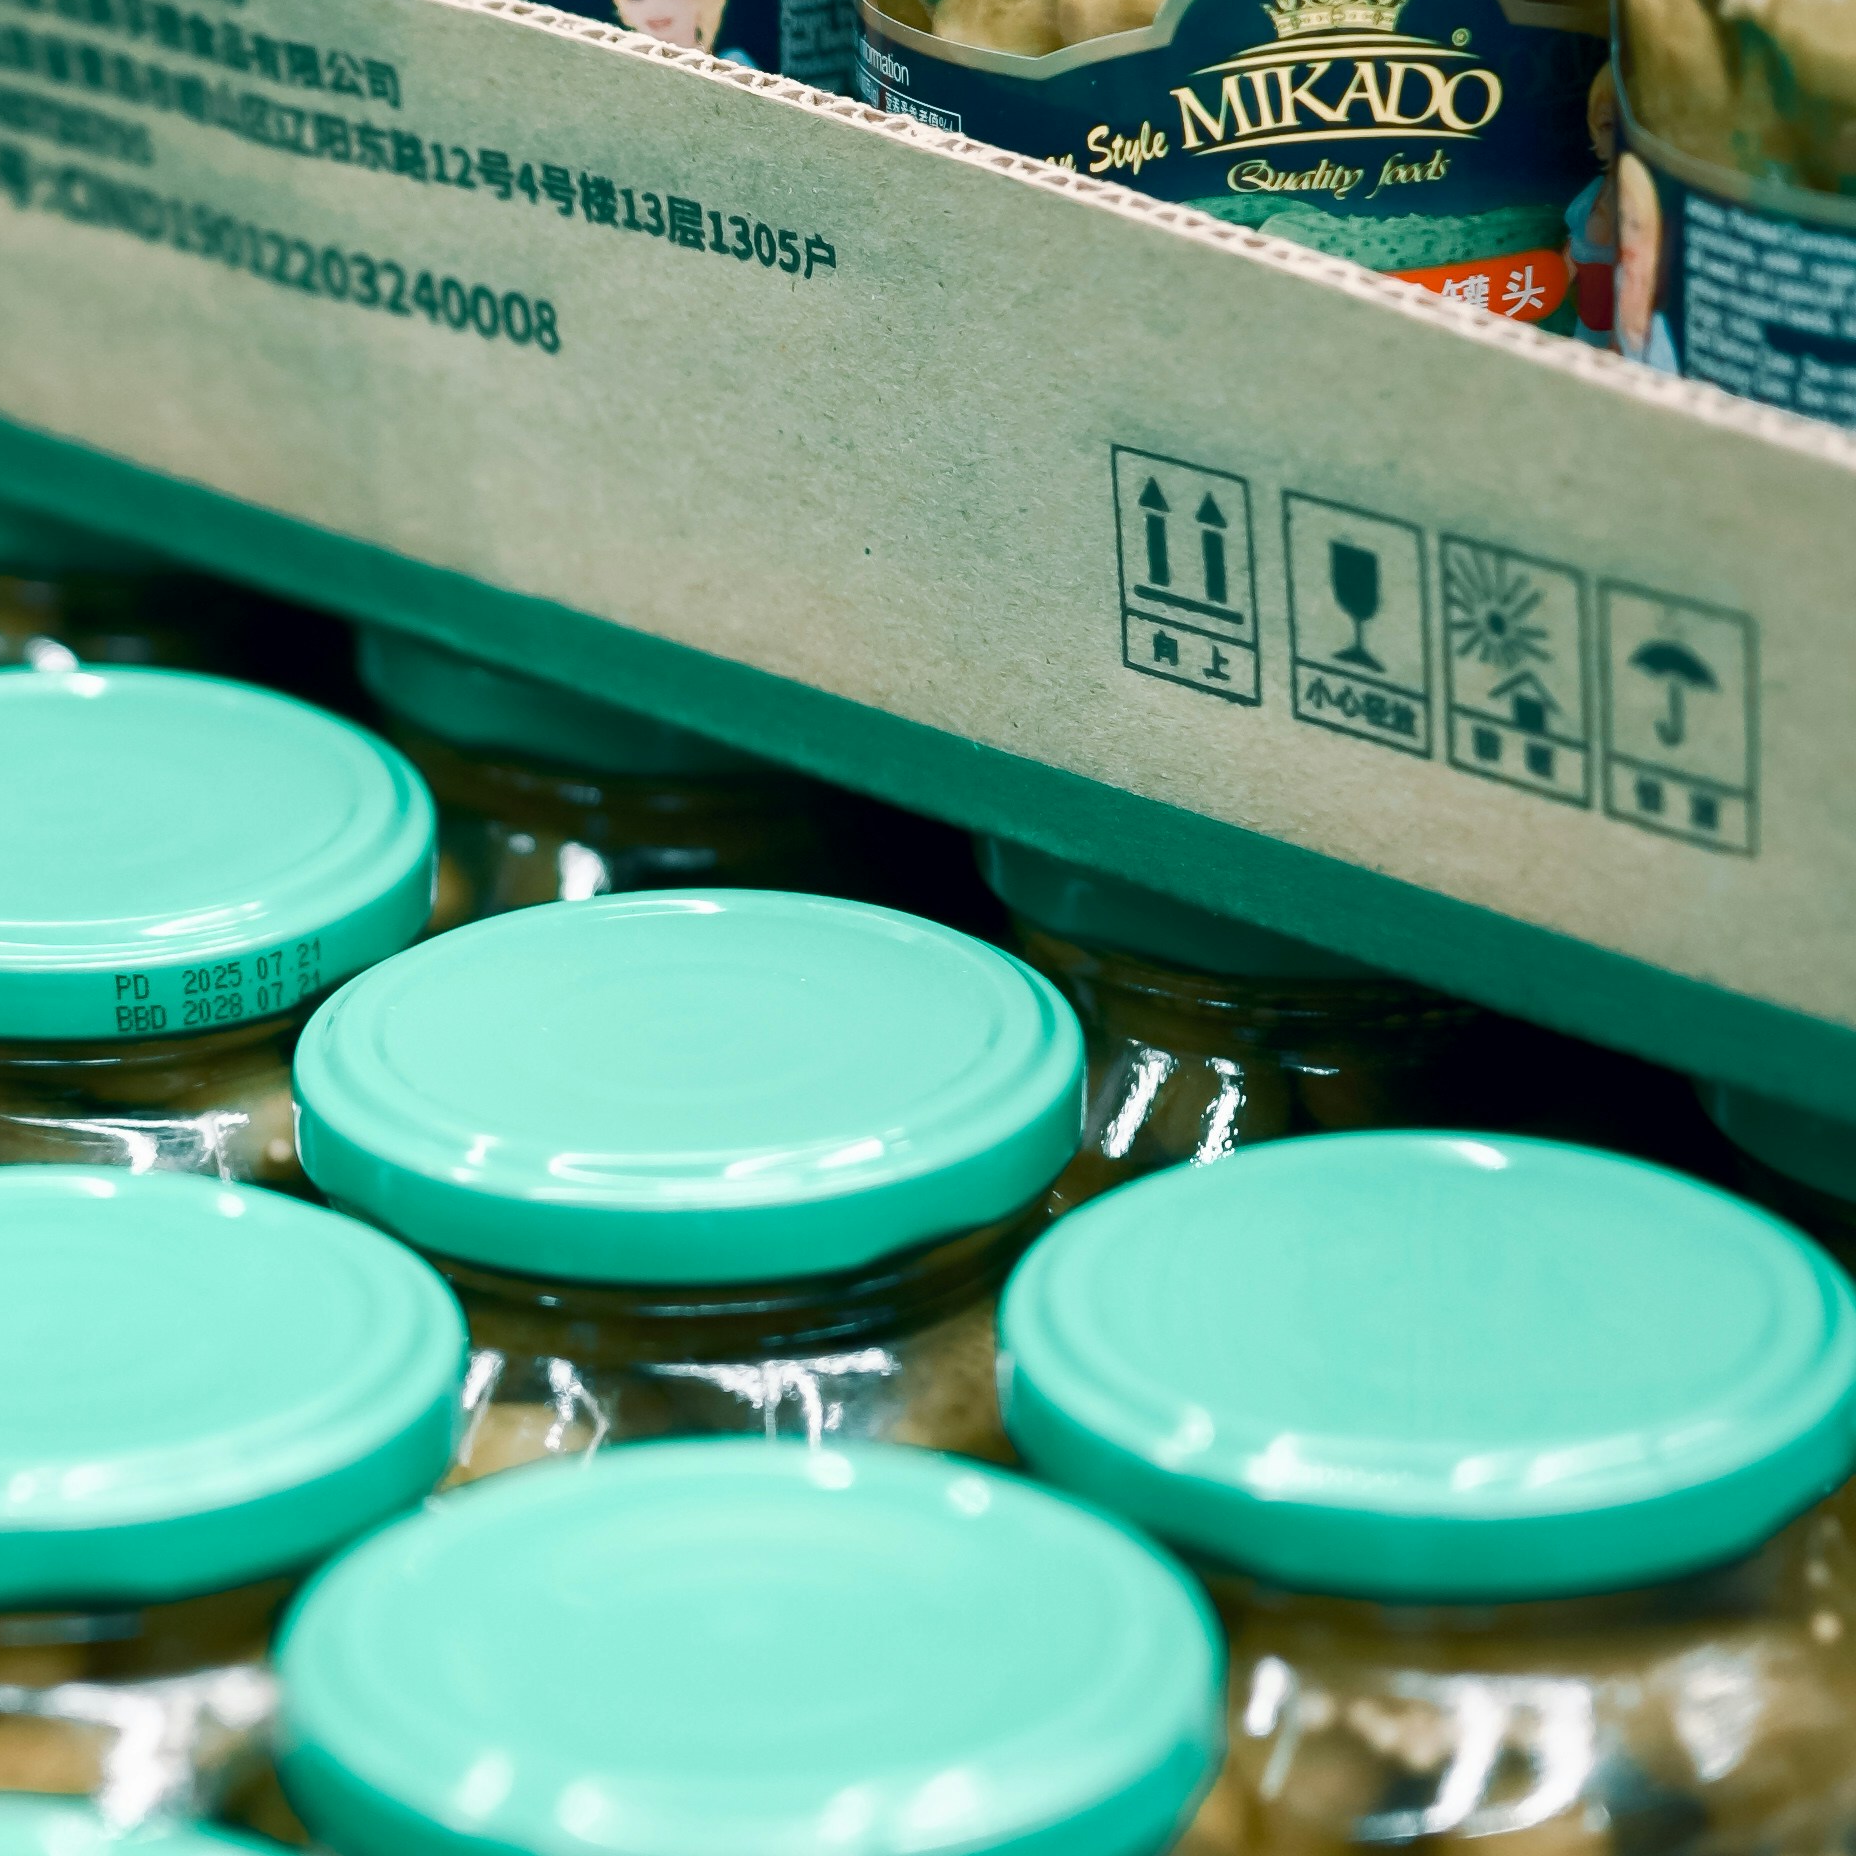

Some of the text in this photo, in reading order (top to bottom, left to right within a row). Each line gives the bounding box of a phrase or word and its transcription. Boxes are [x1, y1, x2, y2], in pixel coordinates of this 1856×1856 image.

[1170, 61, 1503, 149] MIKADO
[1087, 120, 1170, 176] Style
[1227, 148, 1451, 201] Quality foods
[115, 973, 150, 1000] PD
[115, 1004, 167, 1032] BBD
